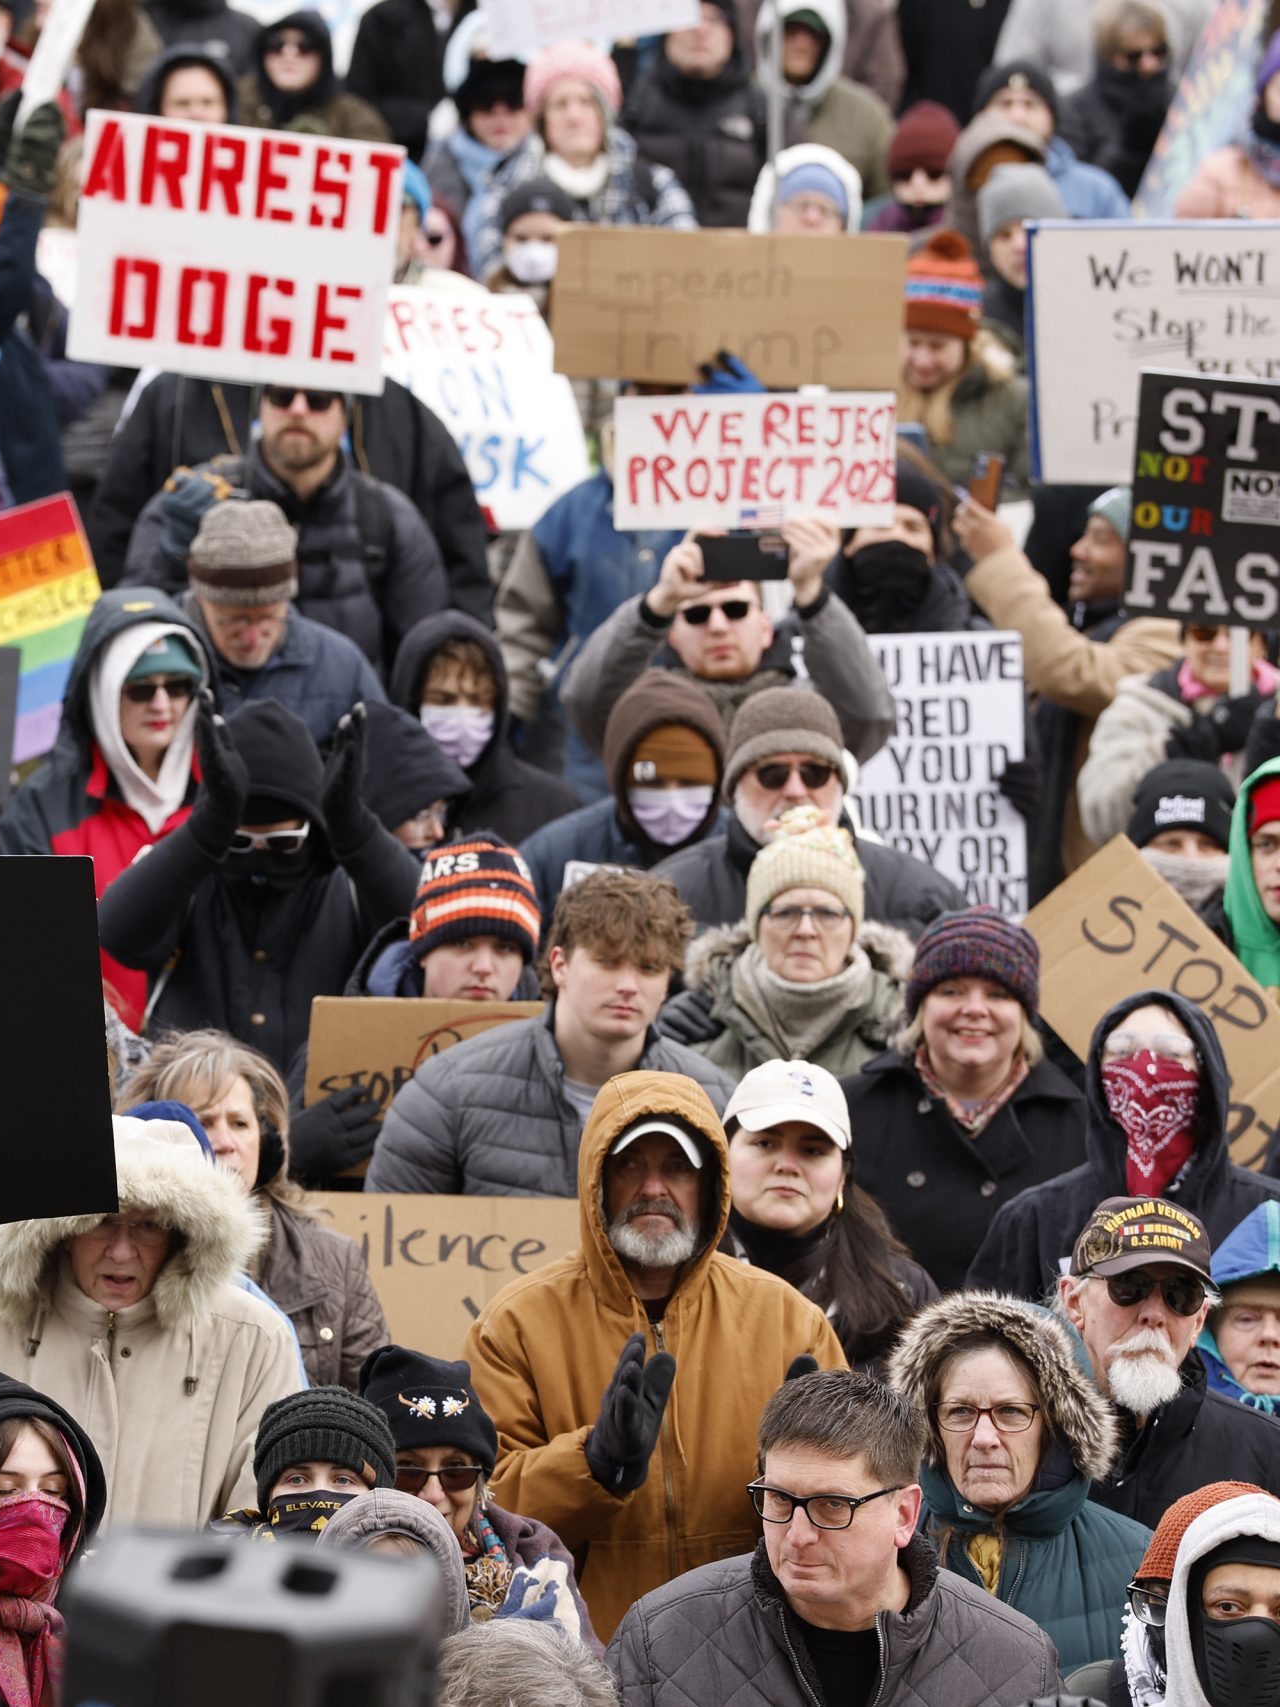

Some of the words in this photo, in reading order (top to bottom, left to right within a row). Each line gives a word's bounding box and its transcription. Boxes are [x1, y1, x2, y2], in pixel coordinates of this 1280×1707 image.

[83, 119, 403, 235] ARREST
[1088, 249, 1153, 292] We
[108, 256, 364, 363] DOGE
[384, 300, 541, 355] RREST
[651, 408, 745, 448] WE
[628, 455, 815, 507] PROJECT
[1137, 451, 1210, 485] NOT
[1134, 501, 1214, 537] OUR
[919, 641, 1023, 685] HAVE
[895, 696, 972, 738] RED
[417, 851, 481, 888] ARS
[959, 835, 1009, 875] OR
[1081, 894, 1269, 1031] STOP
[360, 1204, 547, 1274] ilence
[1103, 1200, 1156, 1233] VIETNAM
[1156, 1202, 1202, 1241] VETERAN
[285, 1500, 342, 1513] ELEVATE
